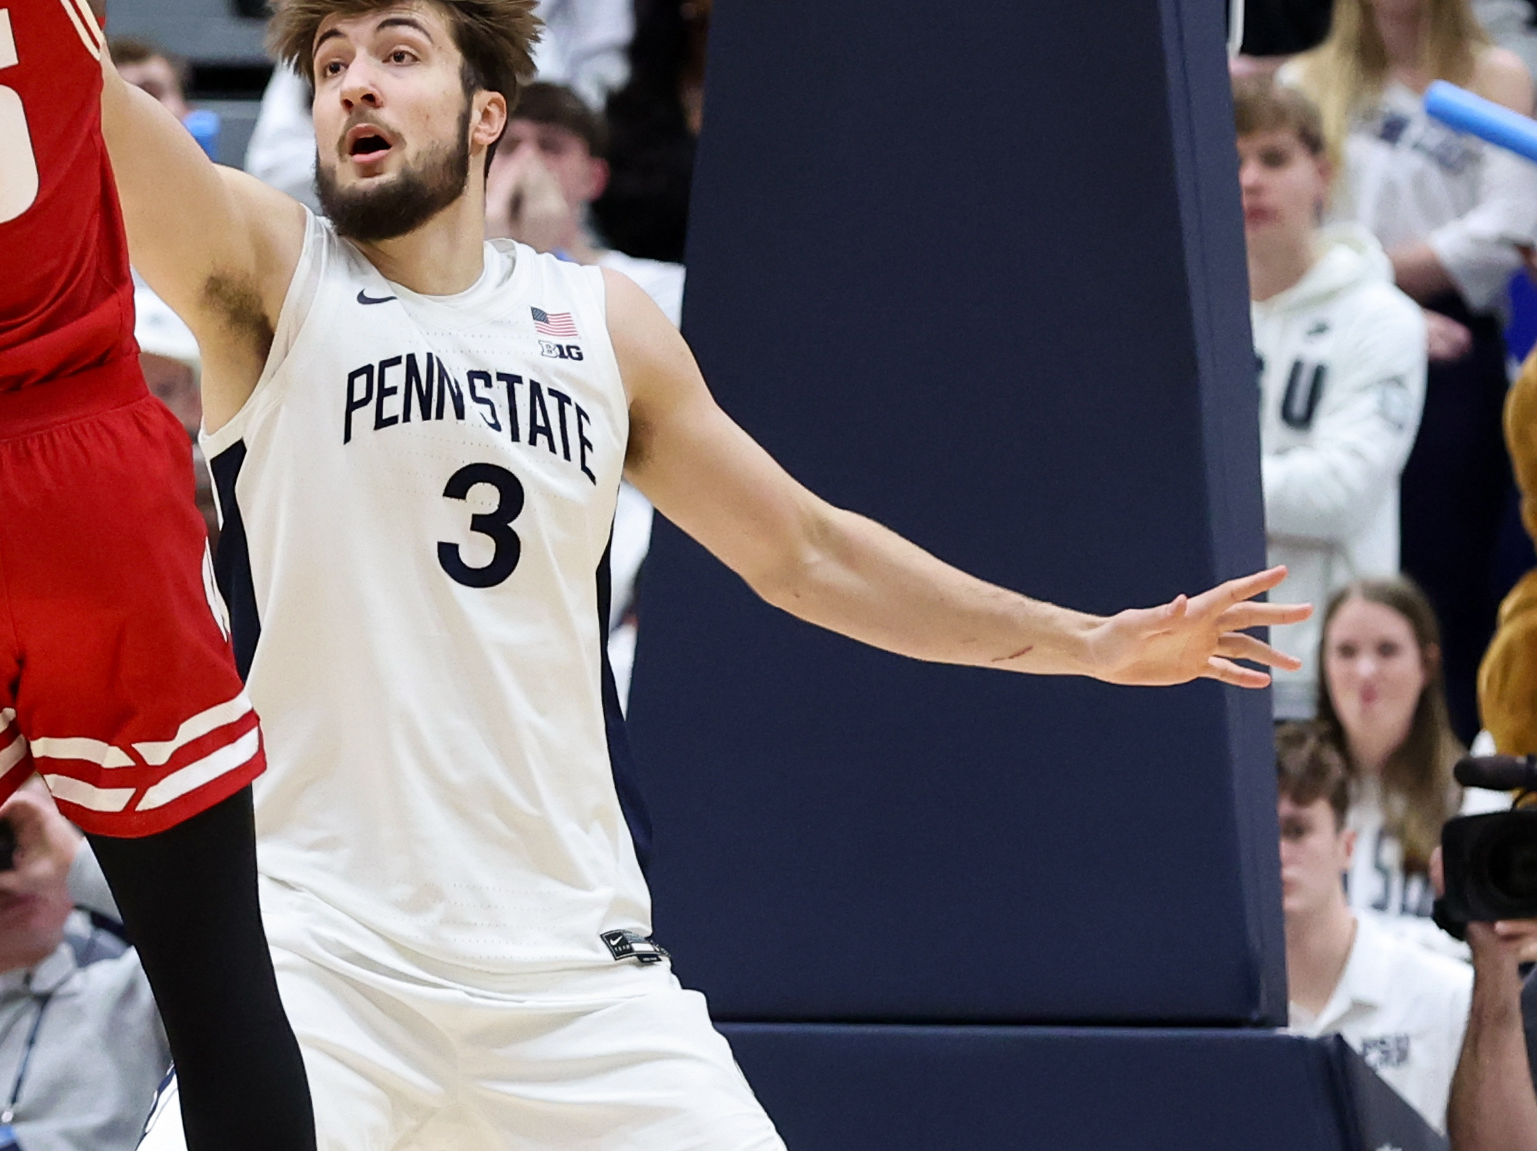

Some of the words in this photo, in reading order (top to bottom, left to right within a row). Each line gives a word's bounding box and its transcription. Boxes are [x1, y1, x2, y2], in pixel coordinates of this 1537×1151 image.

[343, 352, 465, 445] PENN
[467, 369, 597, 486] STATE
[437, 462, 525, 588] 3
